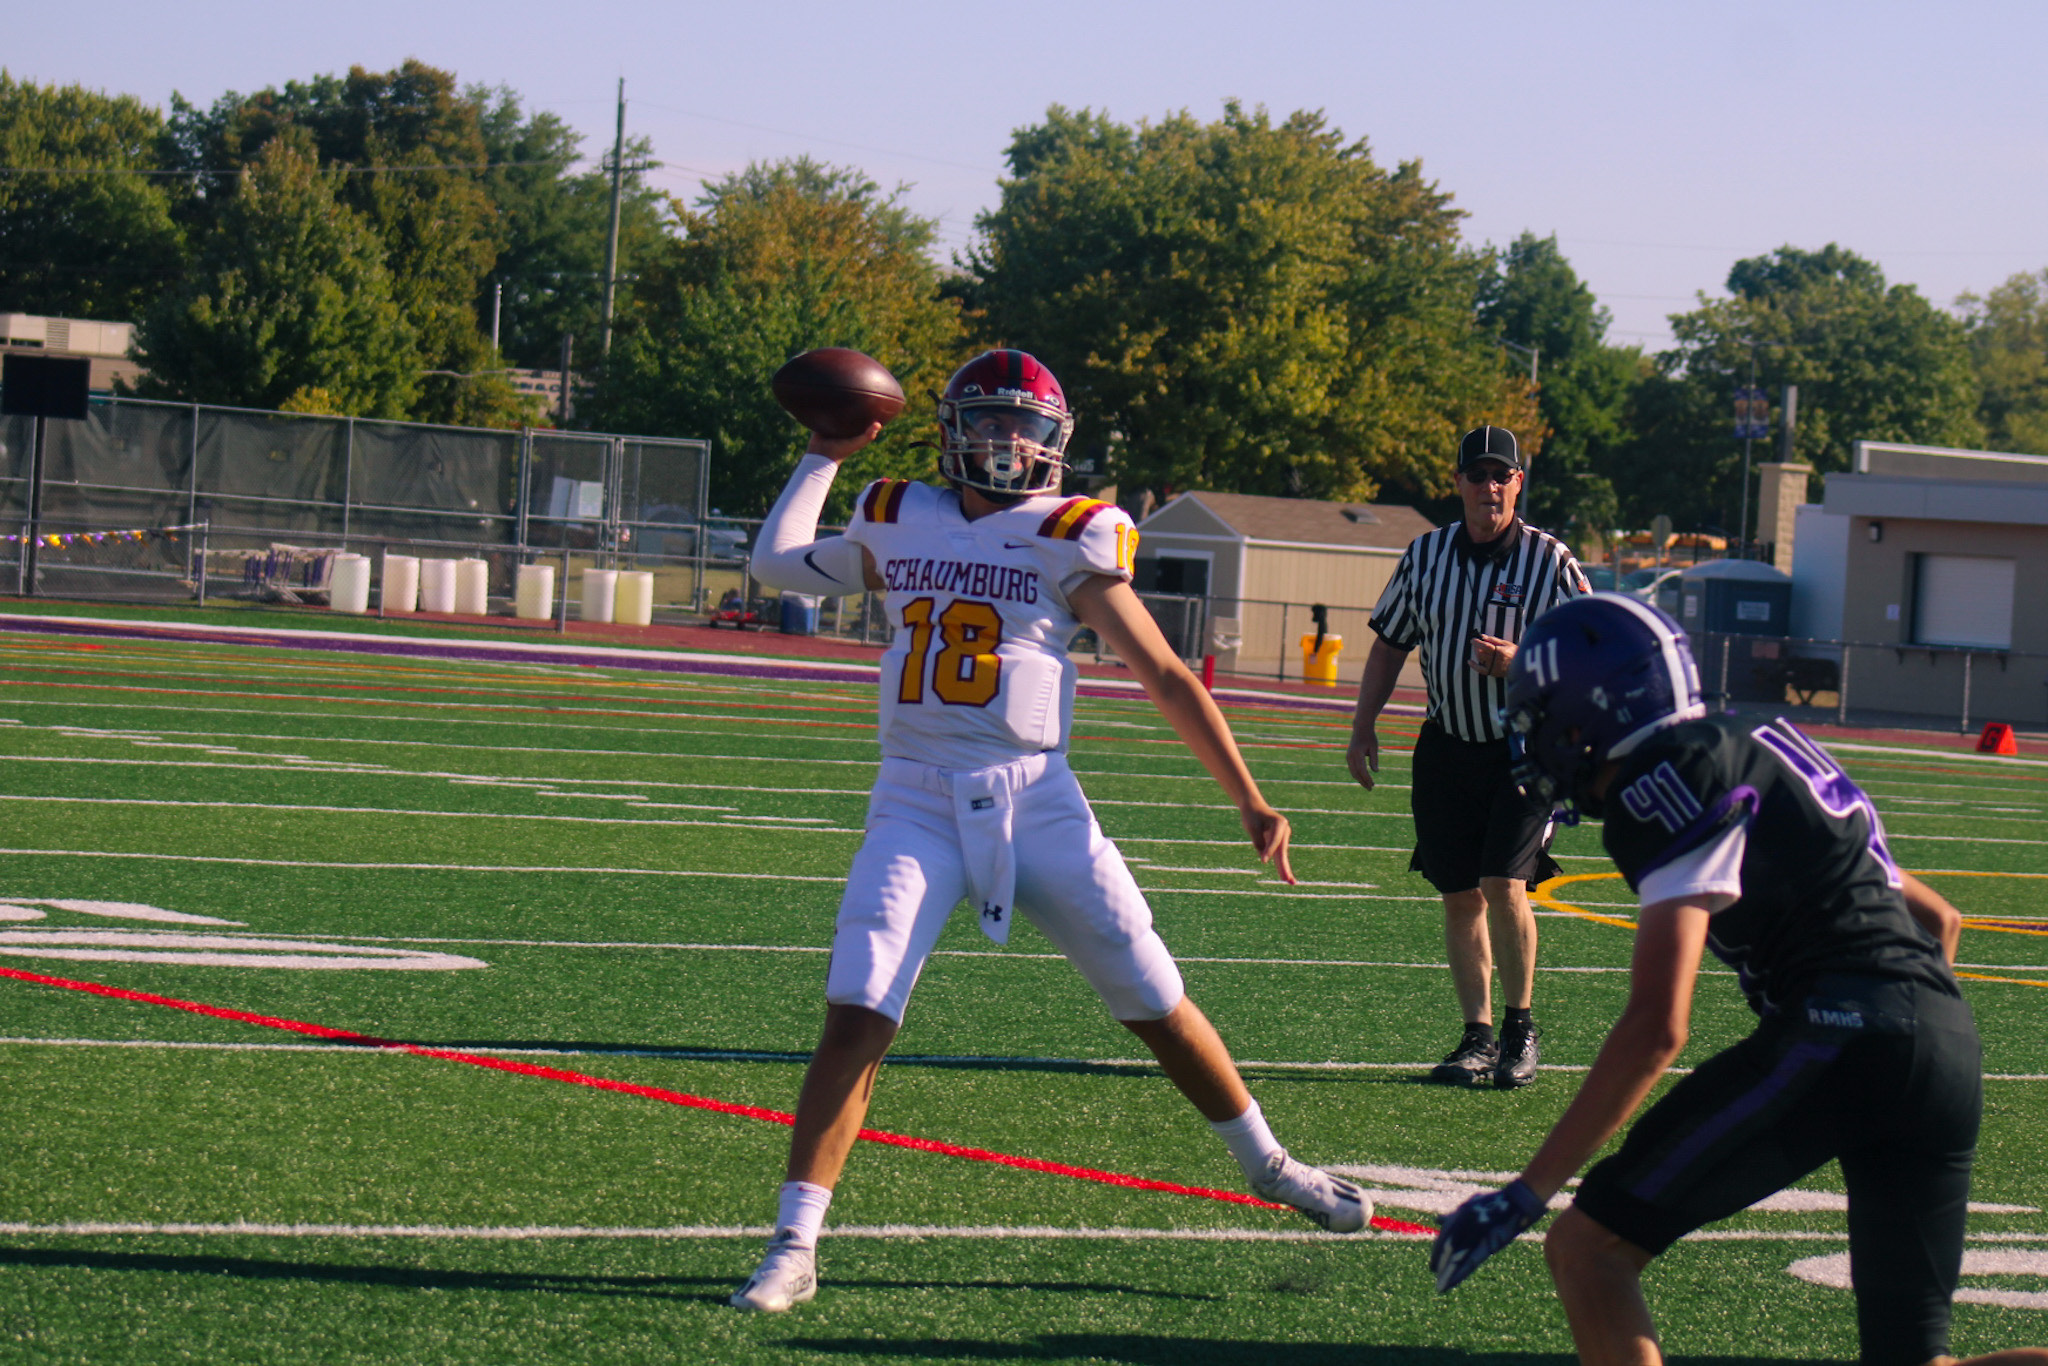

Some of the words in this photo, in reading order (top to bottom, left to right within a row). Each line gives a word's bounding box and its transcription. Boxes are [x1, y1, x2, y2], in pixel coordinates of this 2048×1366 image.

[886, 558, 1038, 604] SCHAUMBURG
[898, 597, 1003, 708] 18
[1525, 638, 1560, 687] 41
[1981, 727, 2001, 750] G
[1620, 761, 1703, 833] 41
